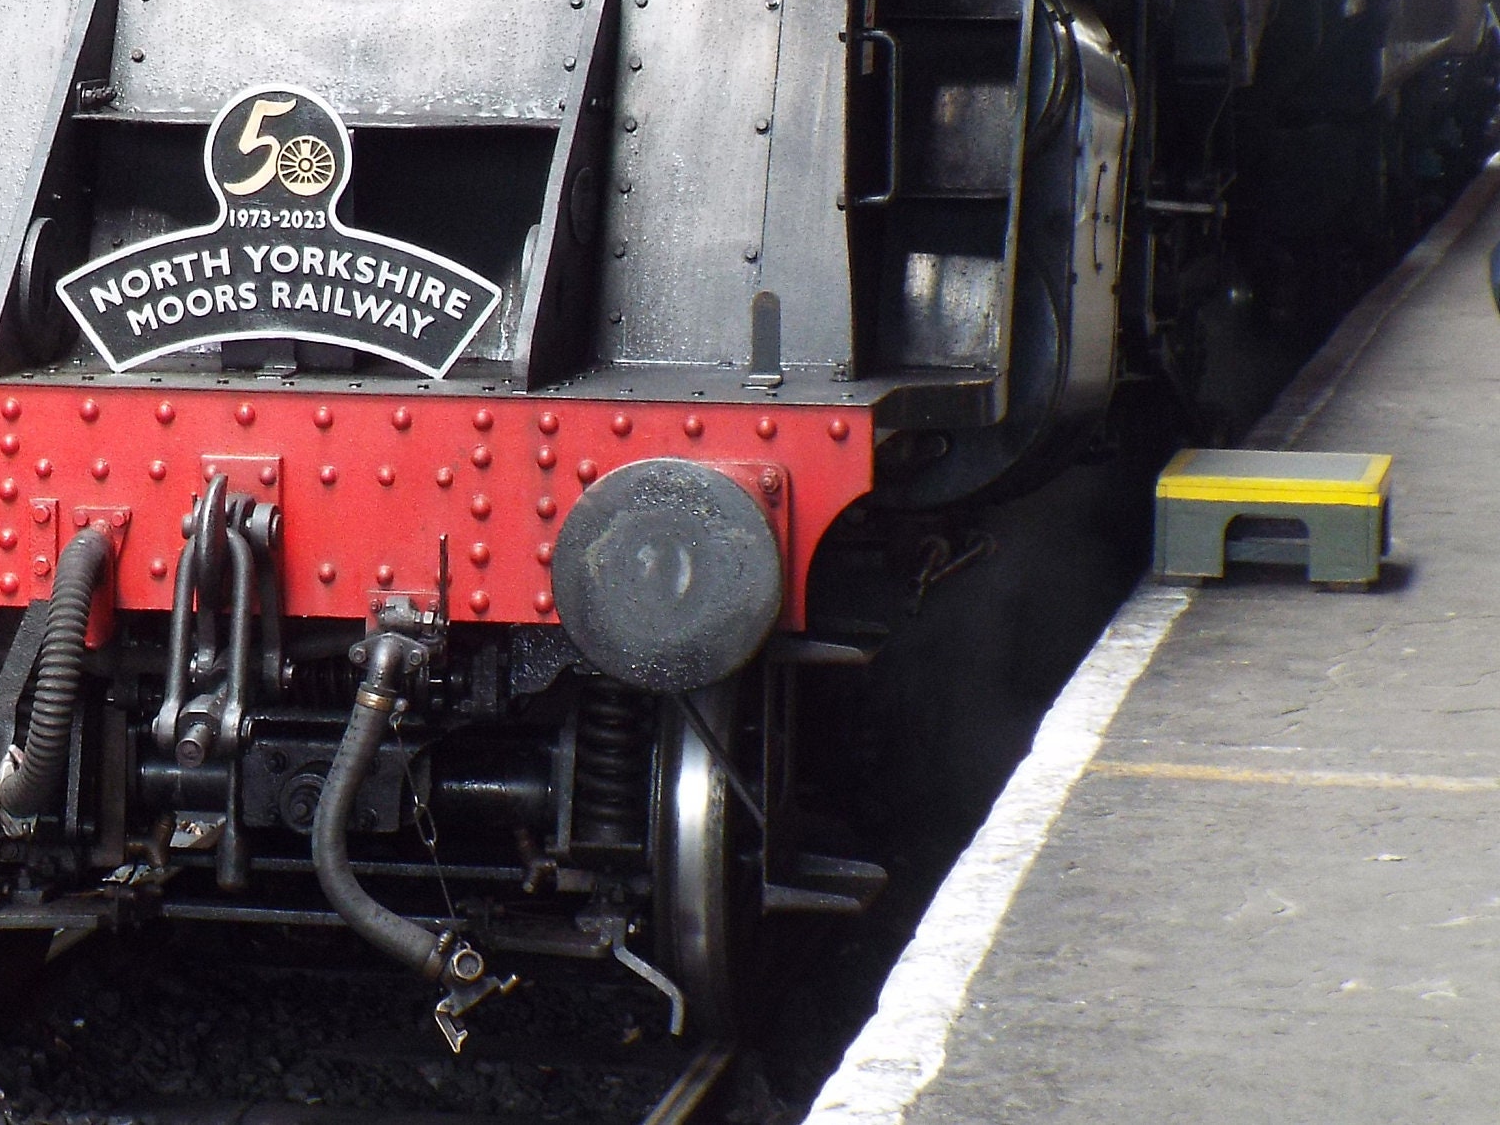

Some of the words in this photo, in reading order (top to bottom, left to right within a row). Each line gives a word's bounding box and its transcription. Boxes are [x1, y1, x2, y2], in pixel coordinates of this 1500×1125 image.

[229, 209, 326, 228] 1973-2023
[89, 248, 231, 313] NORTH
[243, 245, 471, 320] YORKSHIRE
[126, 282, 257, 336] MOORS
[271, 281, 435, 339] RAILWAY
